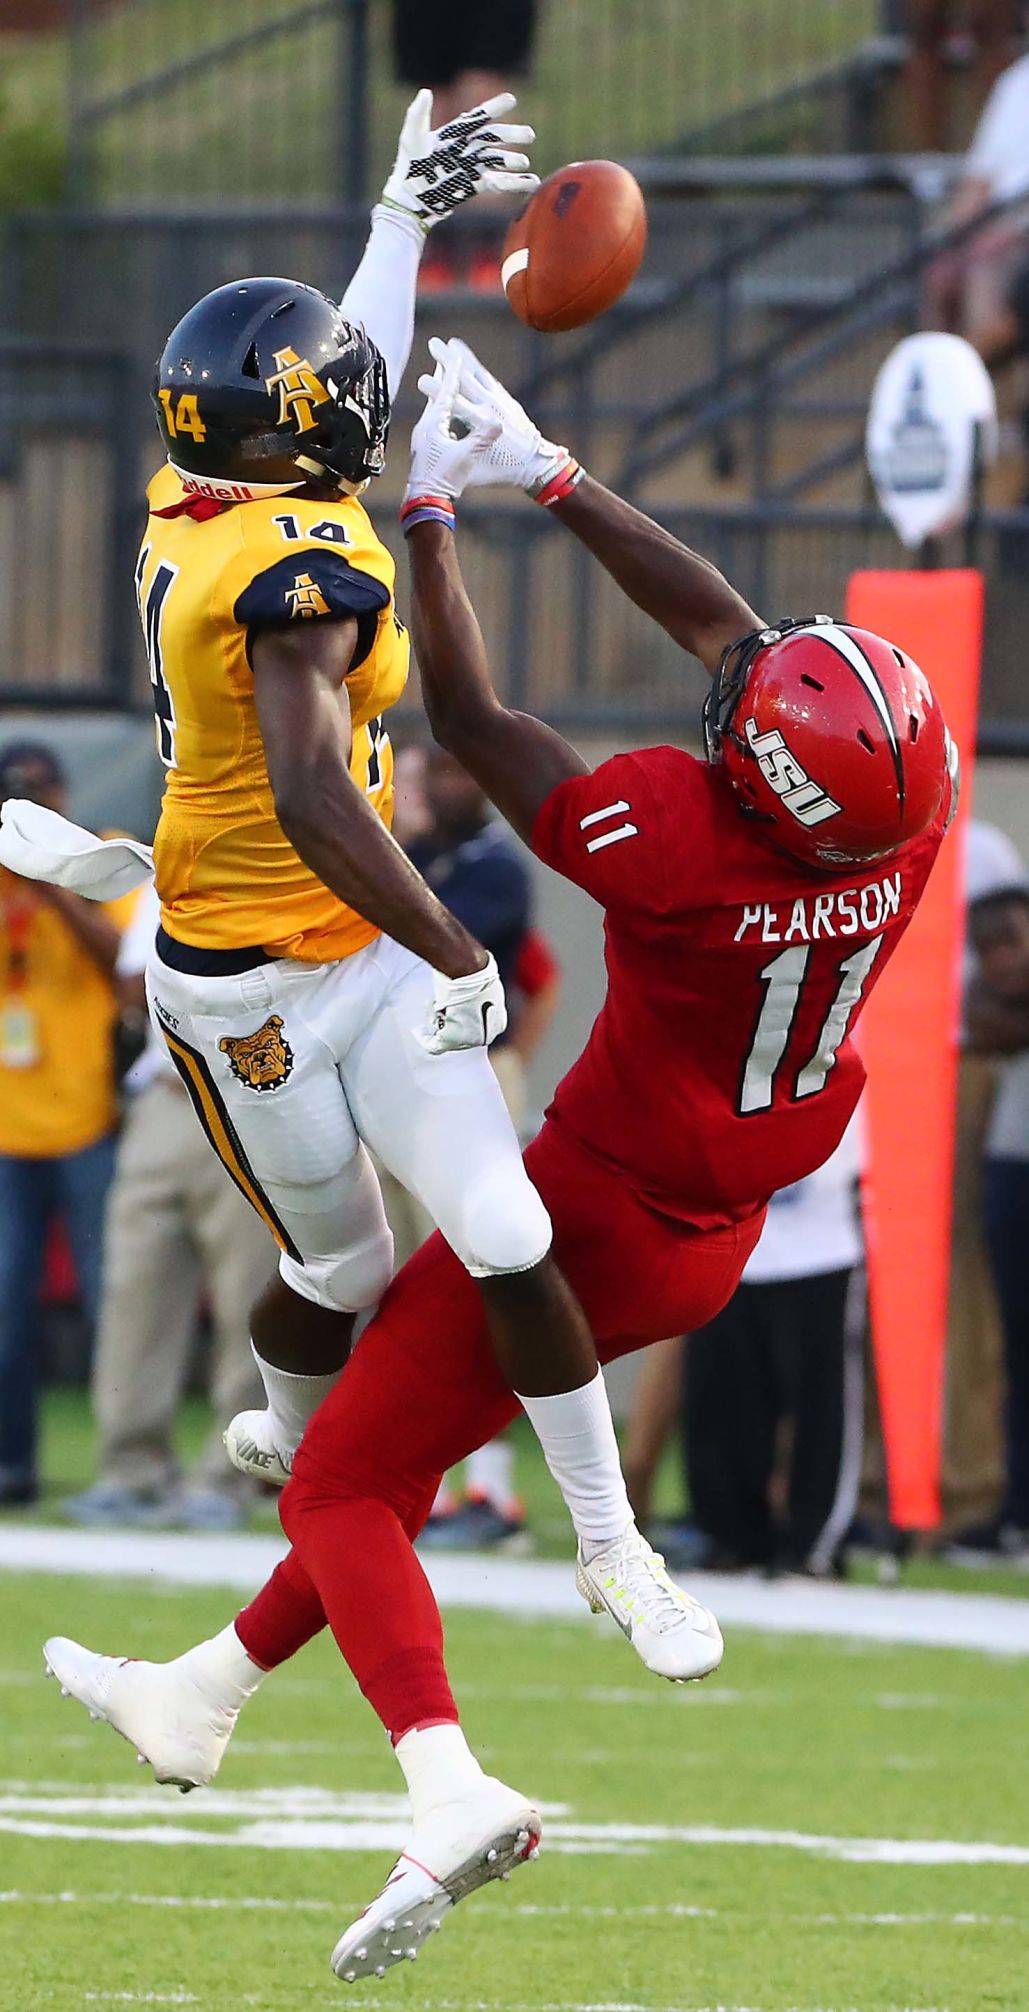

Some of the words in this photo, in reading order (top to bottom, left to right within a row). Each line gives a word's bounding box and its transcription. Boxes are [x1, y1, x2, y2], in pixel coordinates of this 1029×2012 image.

[158, 388, 206, 443] 14
[183, 478, 254, 499] ddell
[271, 513, 350, 545] 14
[134, 541, 180, 769] 4
[744, 717, 846, 827] JSU
[579, 800, 639, 854] 11
[733, 872, 903, 942] PEARSON
[737, 932, 884, 1117] 11
